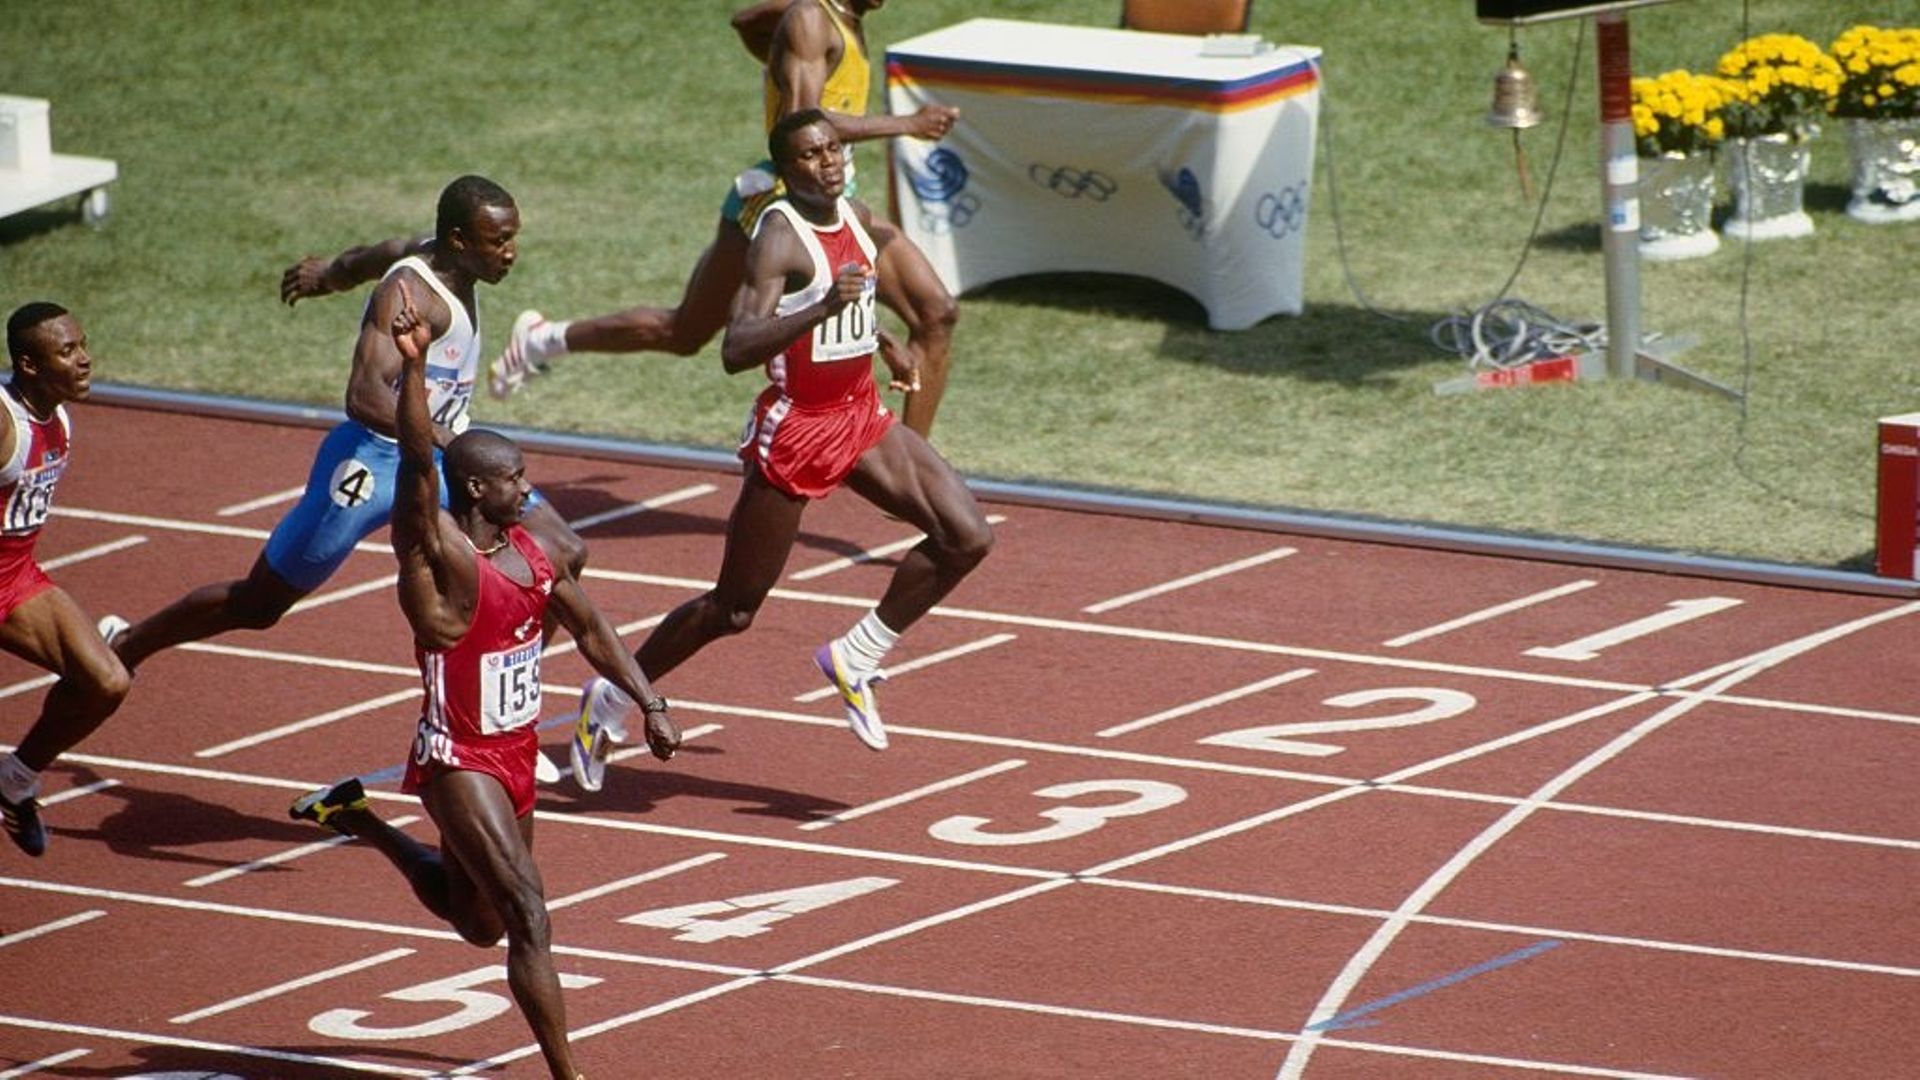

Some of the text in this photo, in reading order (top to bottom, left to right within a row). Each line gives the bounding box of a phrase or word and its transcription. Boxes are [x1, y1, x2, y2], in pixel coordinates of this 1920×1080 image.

[338, 467, 368, 507] 4
[1520, 596, 1745, 661] 1
[499, 658, 540, 717] 159
[1196, 686, 1477, 757] 2
[928, 779, 1188, 846] 3
[617, 876, 902, 943] 4
[307, 964, 605, 1040] 5
